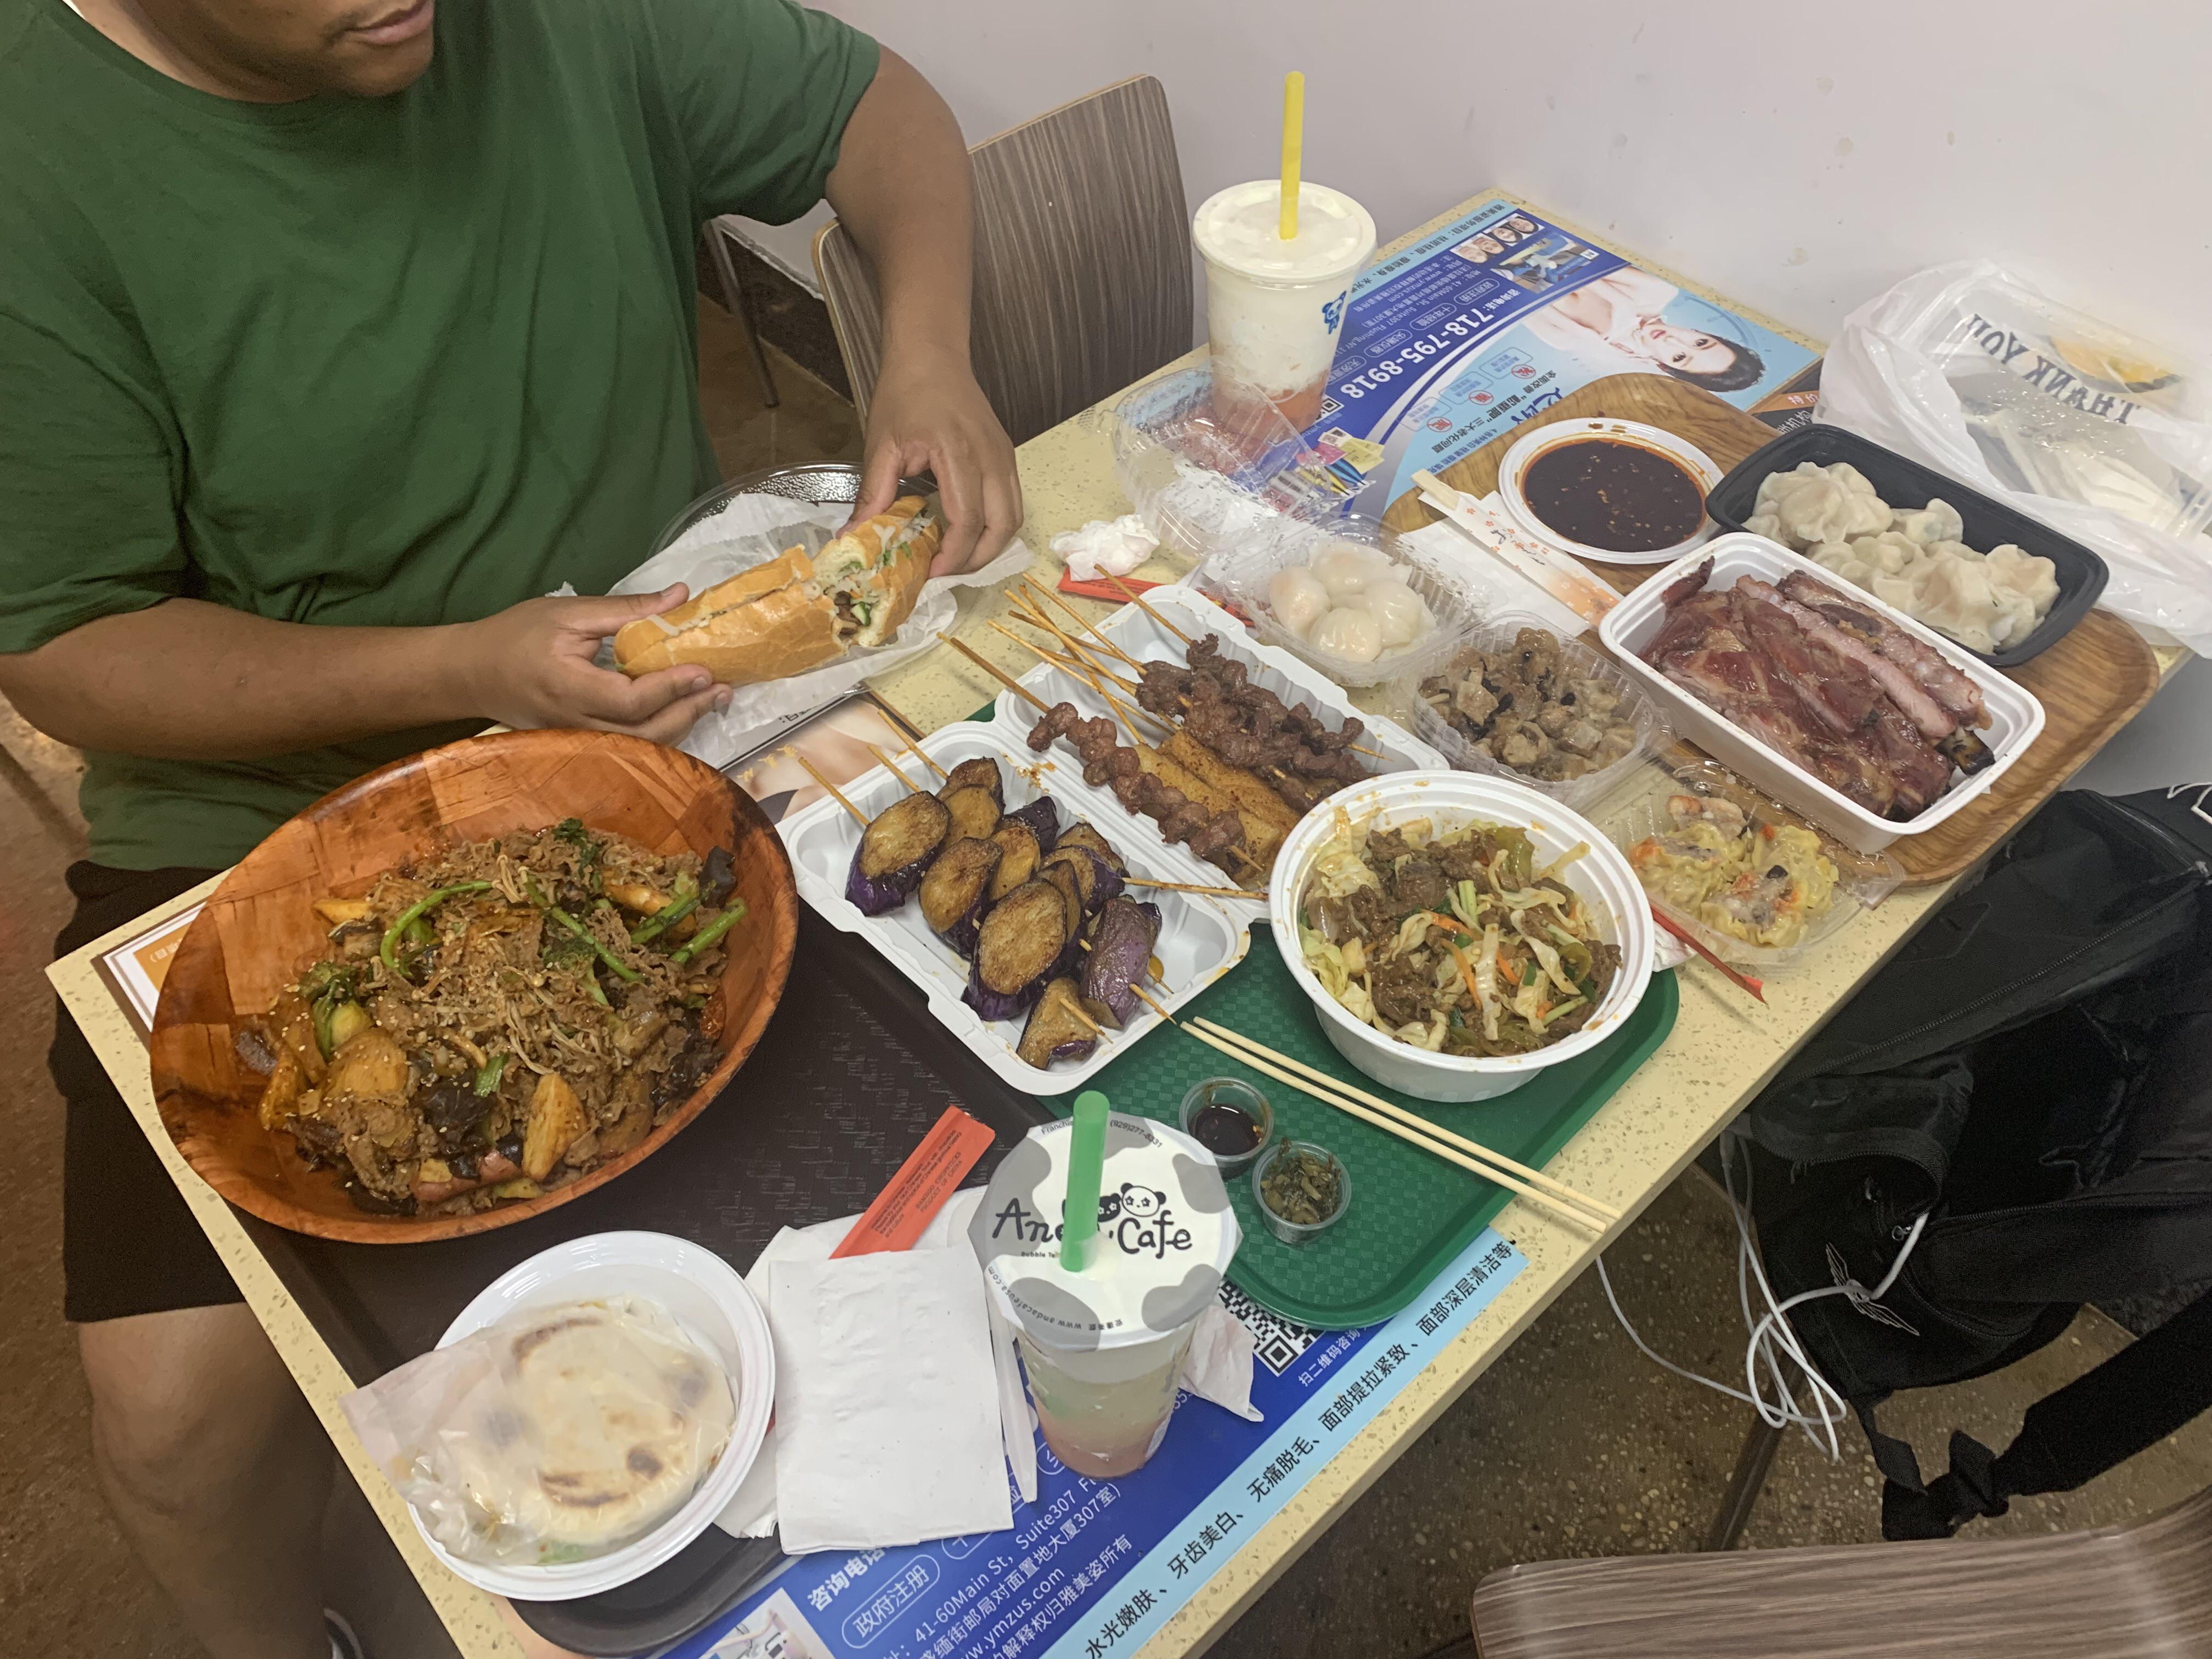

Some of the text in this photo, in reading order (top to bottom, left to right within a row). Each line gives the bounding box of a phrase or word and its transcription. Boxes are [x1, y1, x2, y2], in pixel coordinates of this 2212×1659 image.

[1339, 306, 1493, 400] 718-795-8918
[1118, 1210, 1192, 1259] Cafe
[1298, 1325, 1363, 1387] 扫二维码咨询
[852, 1565, 929, 1639] 政府注册
[915, 1572, 989, 1643] 41-60Main
[1015, 1489, 1076, 1550] Suite307
